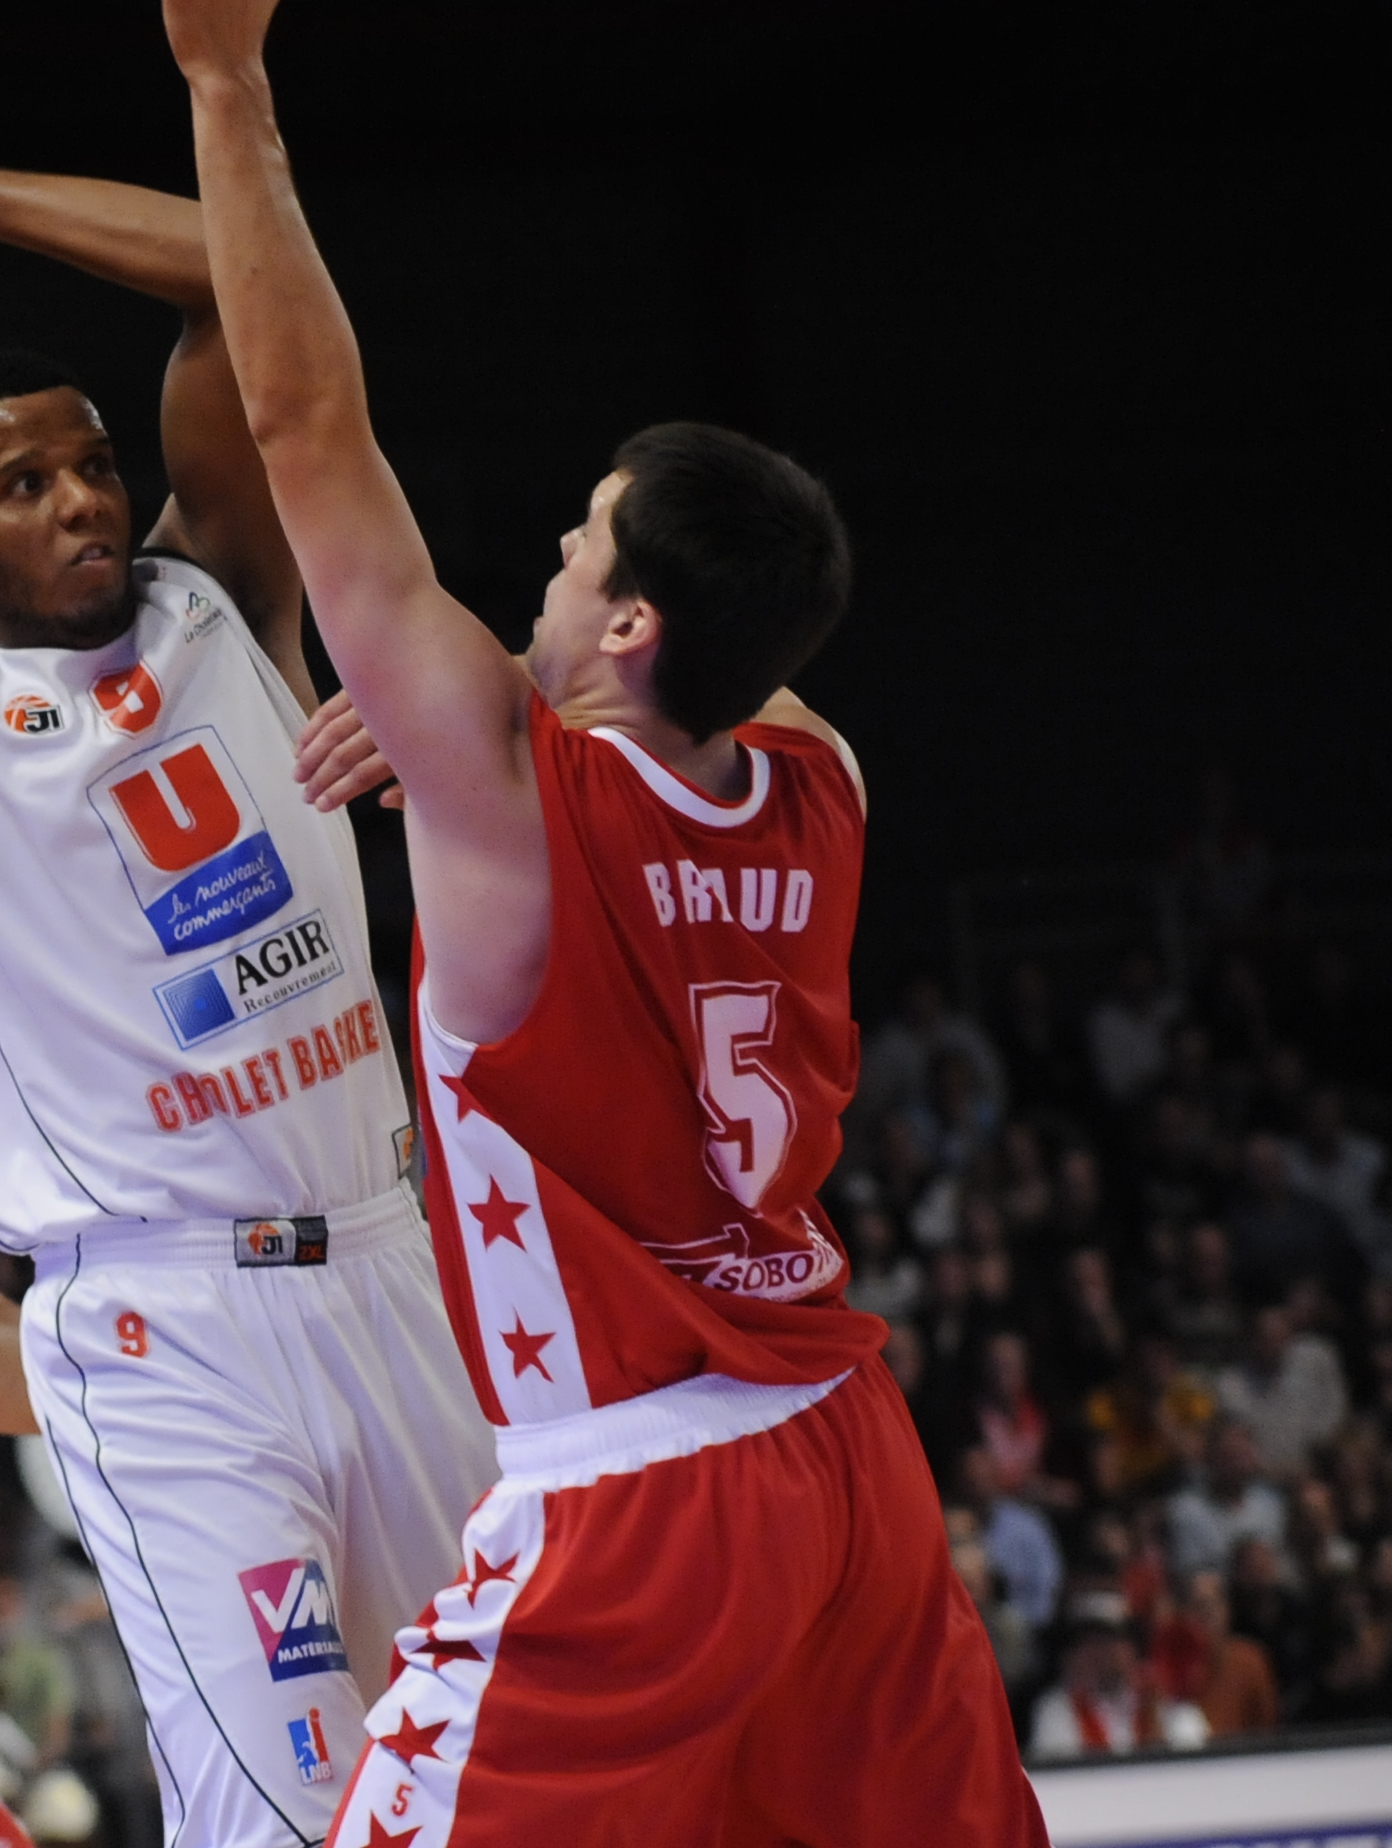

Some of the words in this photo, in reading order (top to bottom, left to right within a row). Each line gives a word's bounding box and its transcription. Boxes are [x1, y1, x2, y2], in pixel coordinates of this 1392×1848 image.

[109, 743, 240, 872] U
[167, 893, 192, 925] les
[234, 920, 330, 996] AGIR
[243, 960, 337, 1014] Recouvrement
[688, 980, 797, 1218] 5
[116, 1311, 148, 1358] 9
[250, 1567, 336, 1634] VM
[391, 1783, 414, 1817] 5
